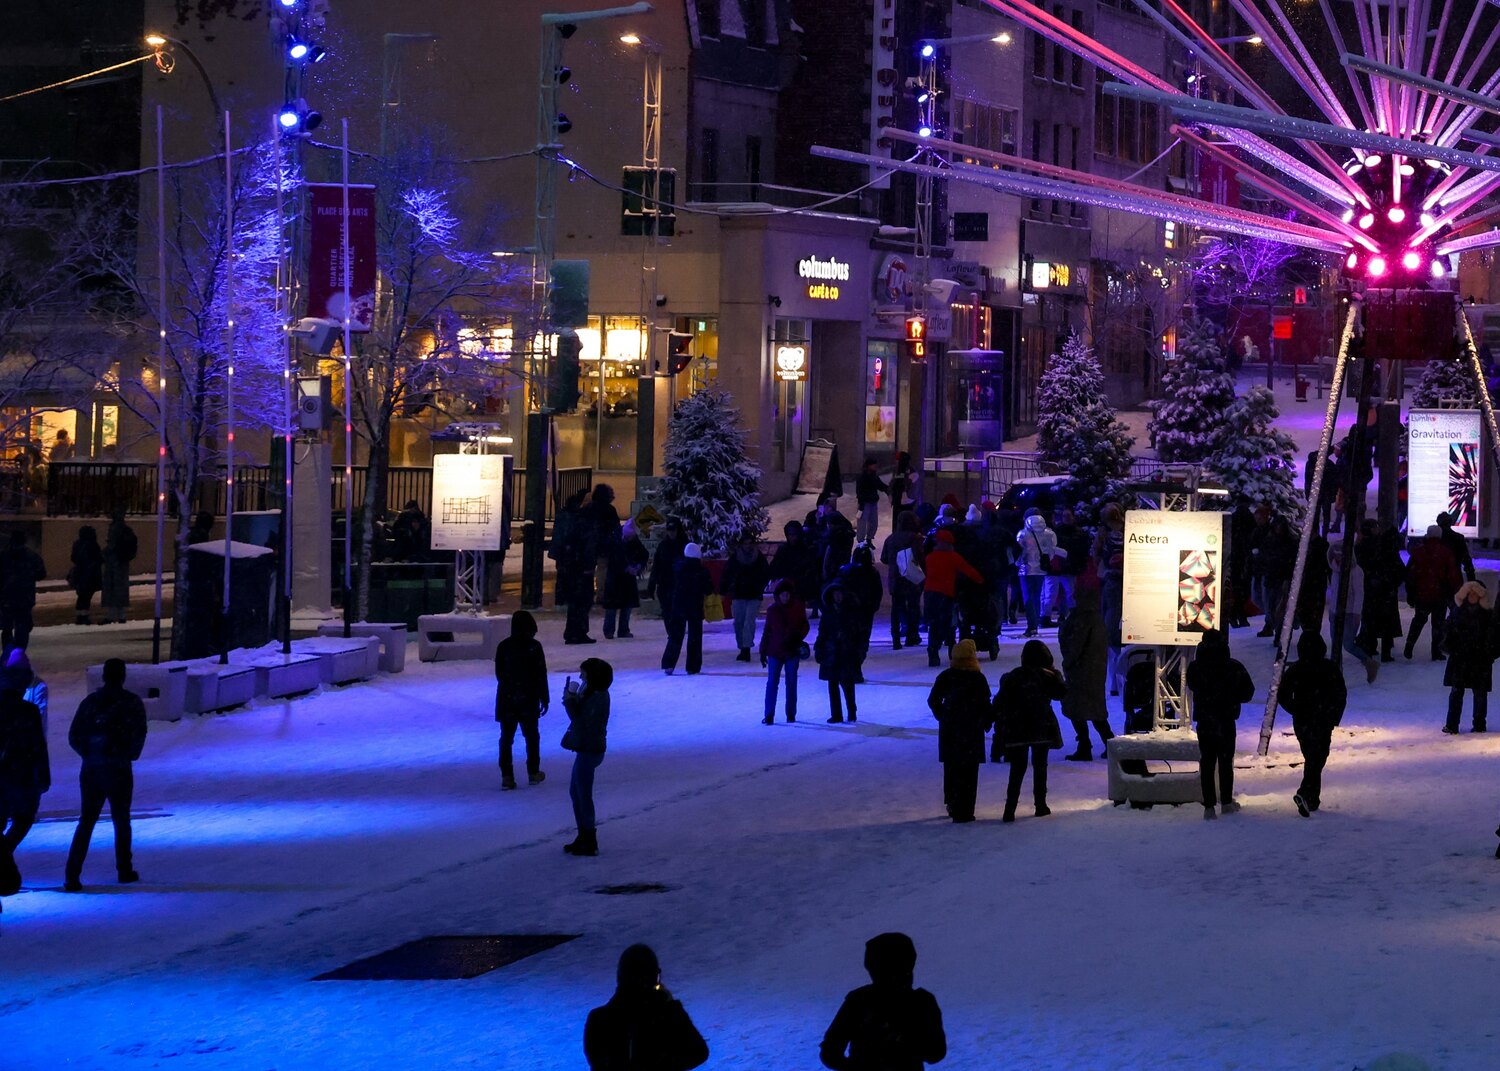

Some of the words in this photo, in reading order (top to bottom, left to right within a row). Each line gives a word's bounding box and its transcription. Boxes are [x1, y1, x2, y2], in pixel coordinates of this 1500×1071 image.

[317, 206, 337, 216] PLACE
[330, 248, 338, 288] QUARTIER
[798, 255, 850, 281] columbus
[1411, 429, 1462, 439] Gravitation
[1128, 532, 1169, 545] Astera
